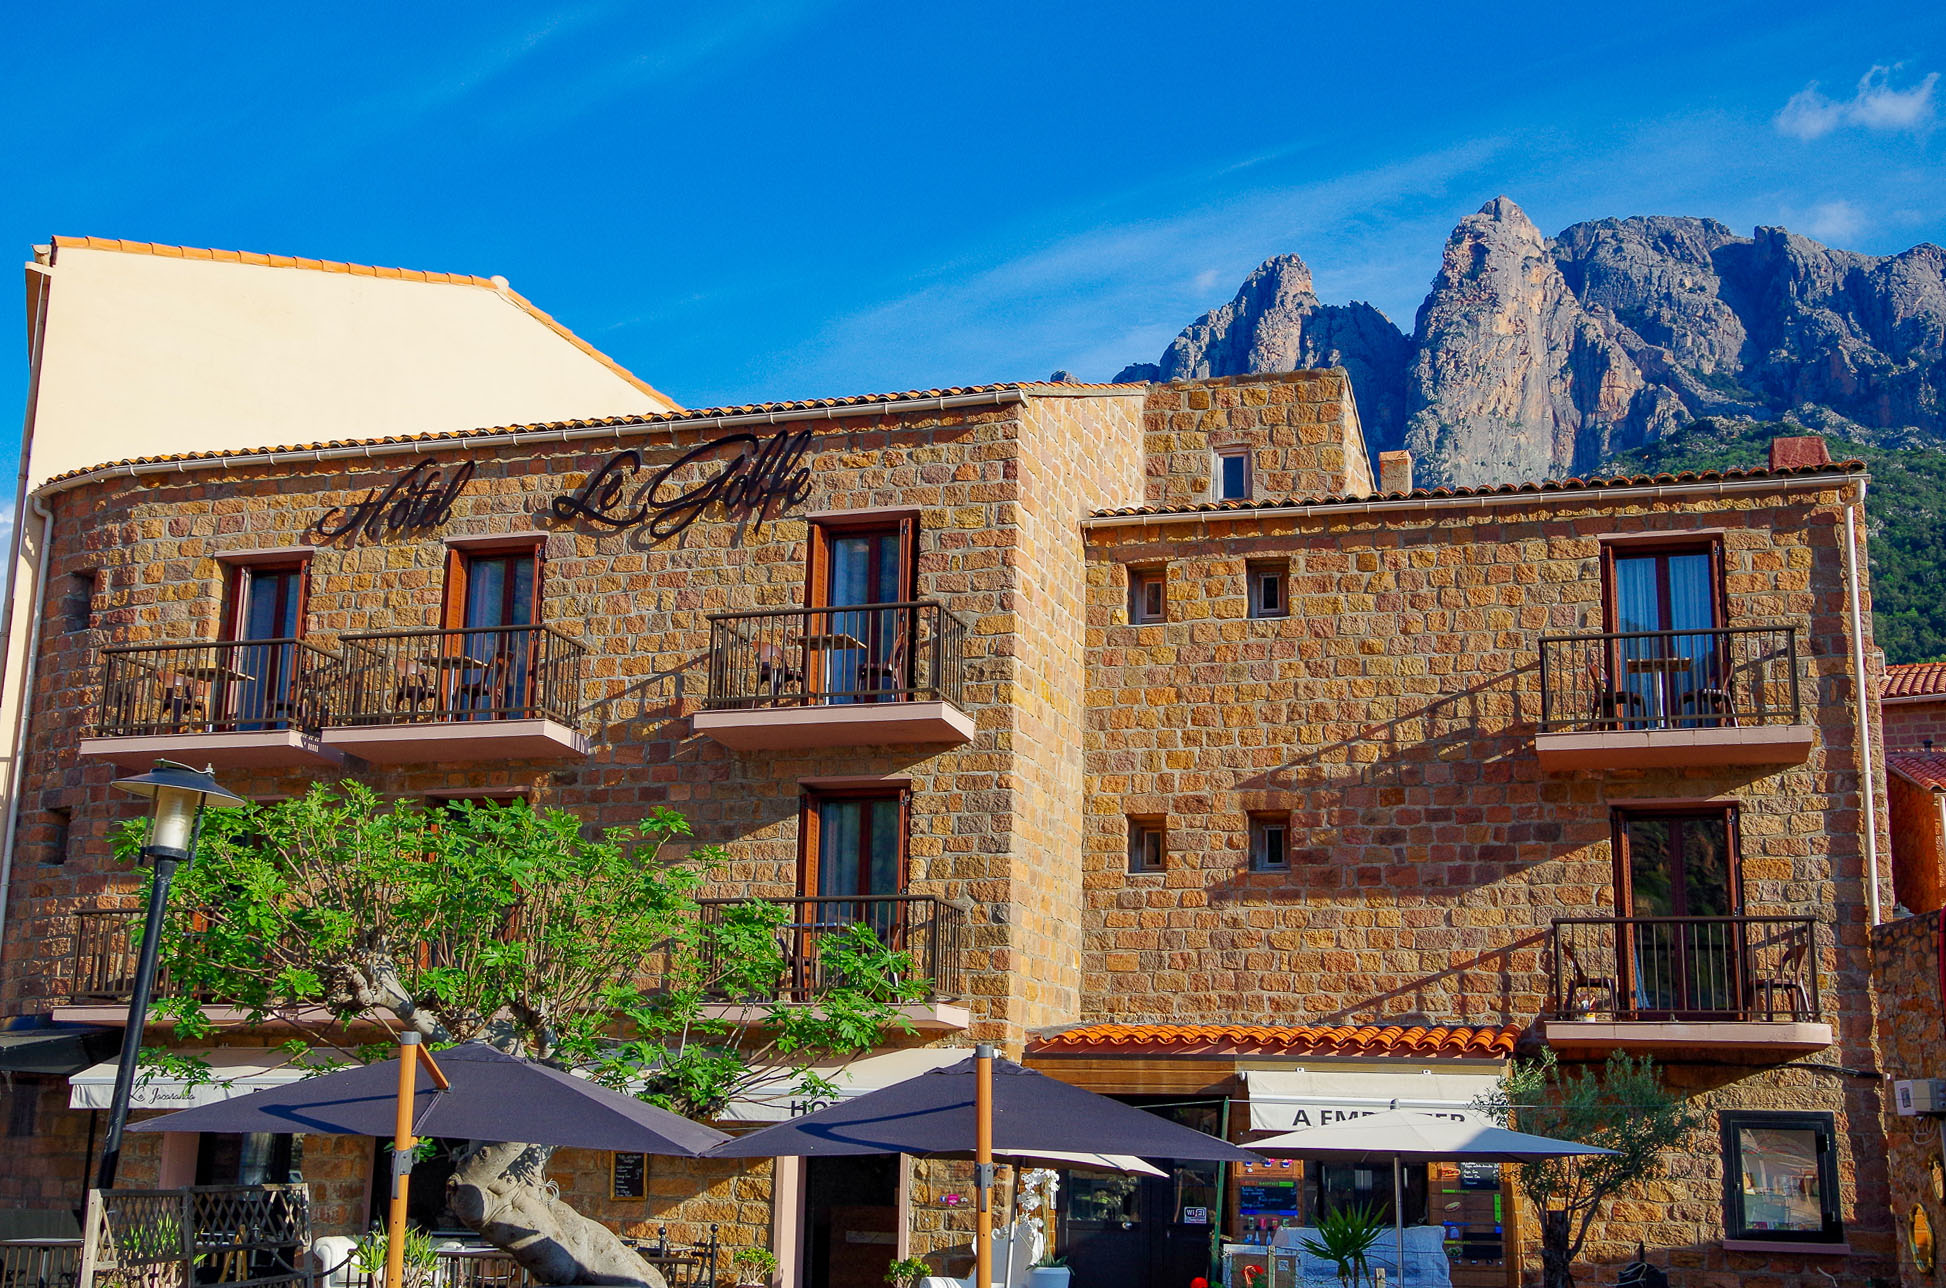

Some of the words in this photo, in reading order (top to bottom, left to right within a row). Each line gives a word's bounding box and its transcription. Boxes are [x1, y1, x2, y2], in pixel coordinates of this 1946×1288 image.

[552, 450, 648, 527] Le
[648, 429, 812, 540] Golfe
[791, 1100, 840, 1117] HO
[1292, 1109, 1311, 1126] A
